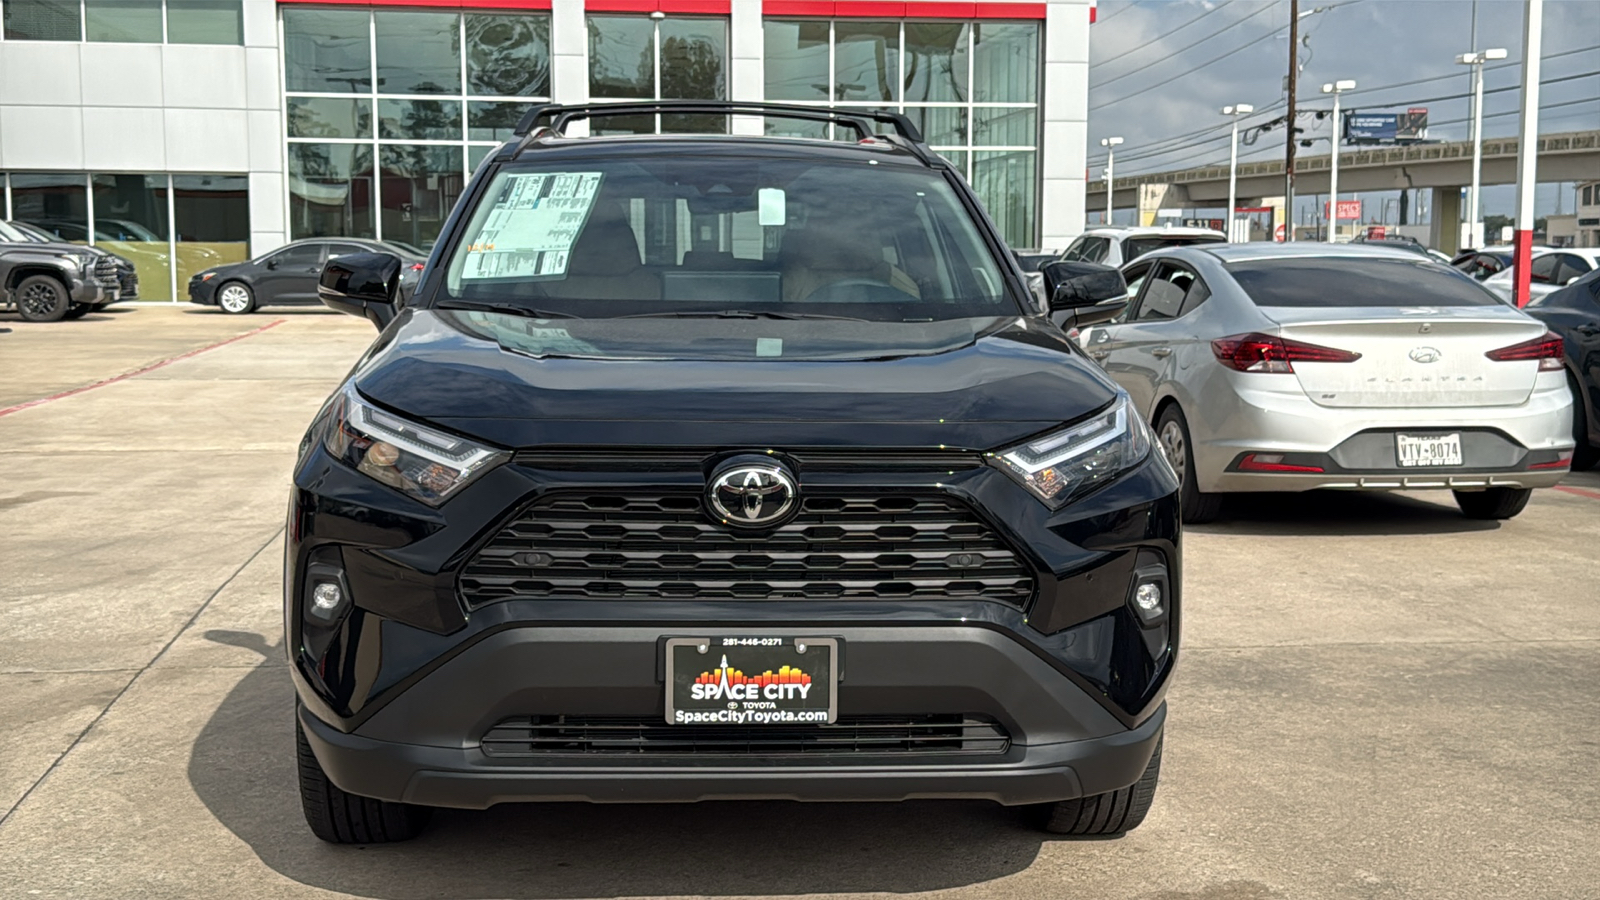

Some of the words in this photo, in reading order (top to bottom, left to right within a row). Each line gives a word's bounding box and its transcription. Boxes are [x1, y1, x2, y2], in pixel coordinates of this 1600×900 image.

[1430, 442, 1458, 459] 8074
[691, 683, 759, 700] SPACE
[763, 683, 812, 700] CITY
[742, 701, 776, 709] TOYOTA
[675, 710, 828, 724] SpaceCityToyota.com
